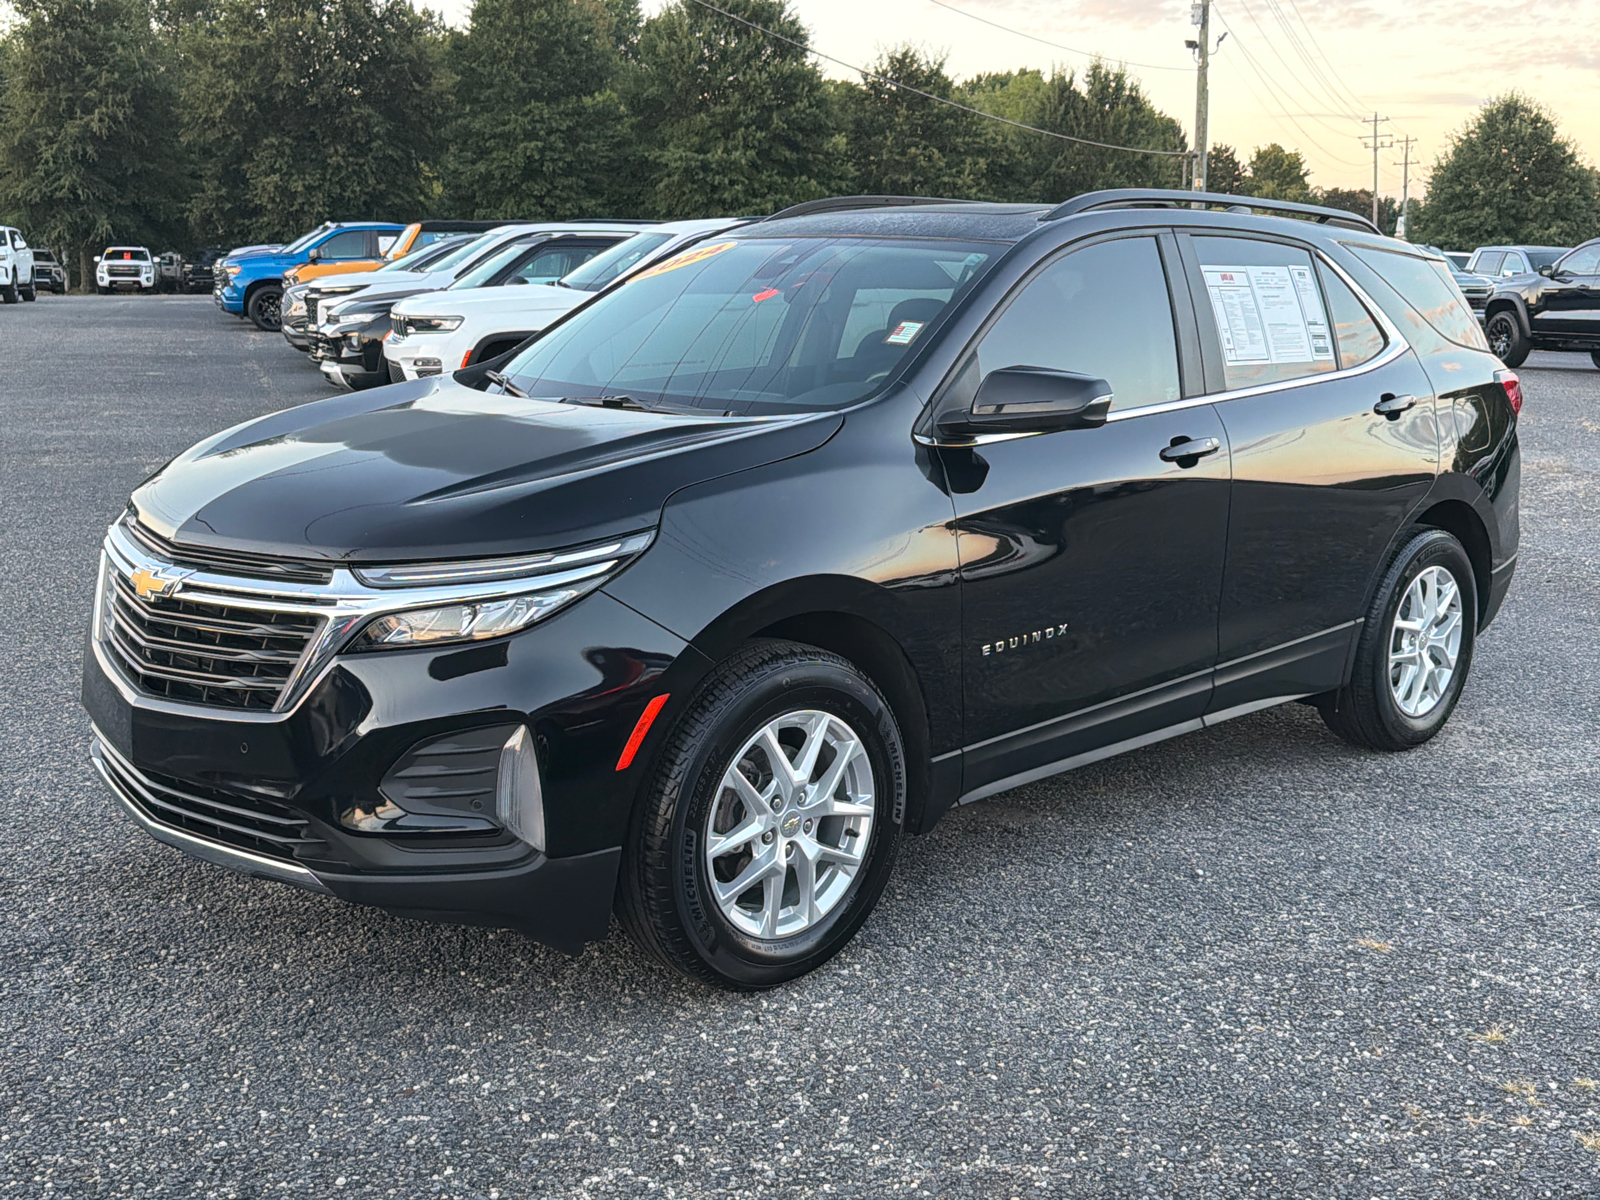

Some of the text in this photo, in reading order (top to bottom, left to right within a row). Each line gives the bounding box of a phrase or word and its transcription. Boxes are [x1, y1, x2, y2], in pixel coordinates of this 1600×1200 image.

[981, 623, 1068, 656] EQUINOX
[888, 741, 904, 821] MICHELIN
[684, 834, 703, 921] MICHELIN
